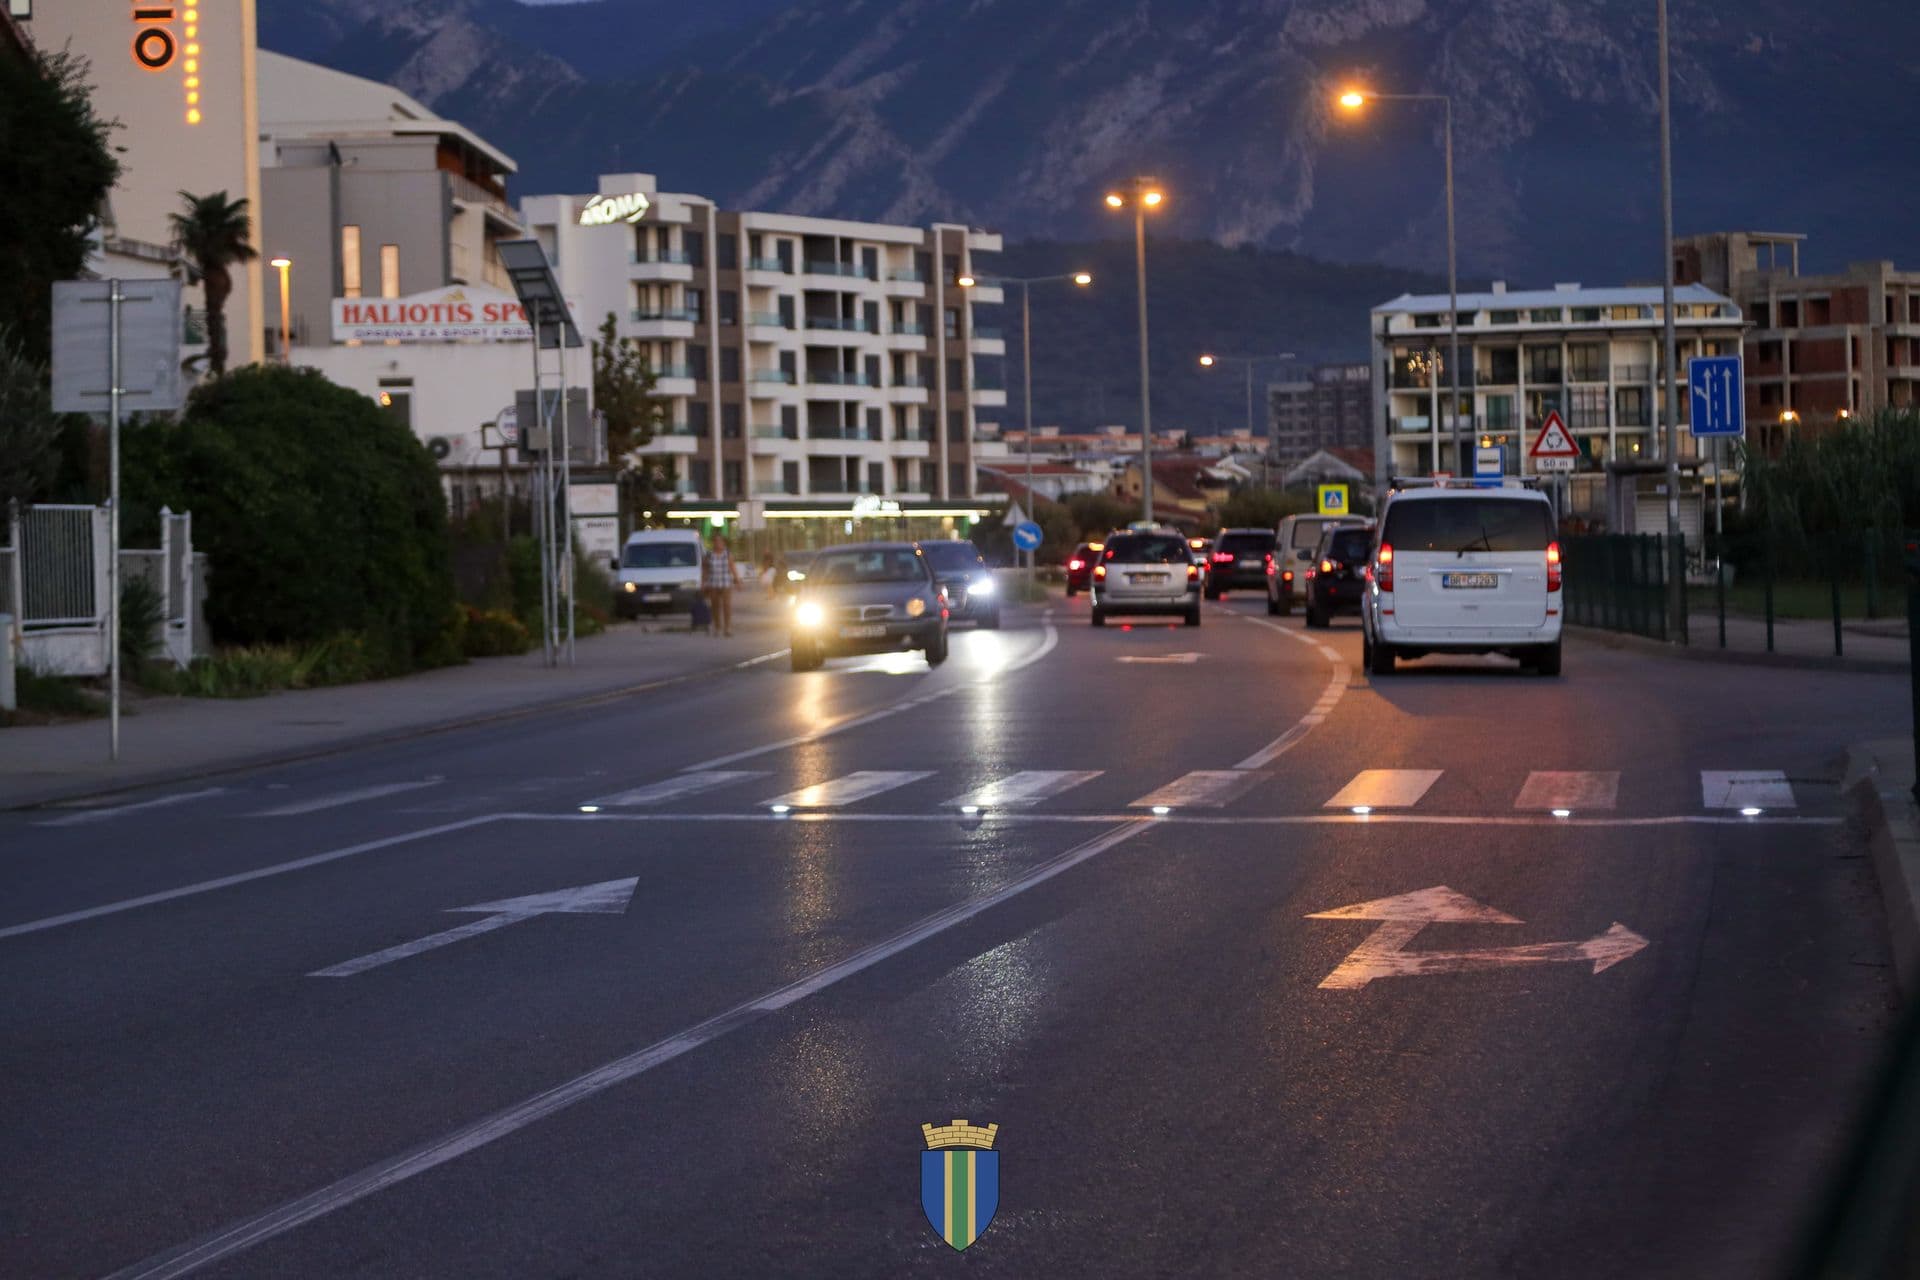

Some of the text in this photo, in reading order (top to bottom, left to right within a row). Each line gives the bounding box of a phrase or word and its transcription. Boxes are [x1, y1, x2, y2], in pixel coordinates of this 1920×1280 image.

[342, 303, 473, 323] HALIOTIS
[354, 329, 413, 337] OPREMA
[420, 329, 437, 337] ZA
[442, 328, 487, 337] SPORT
